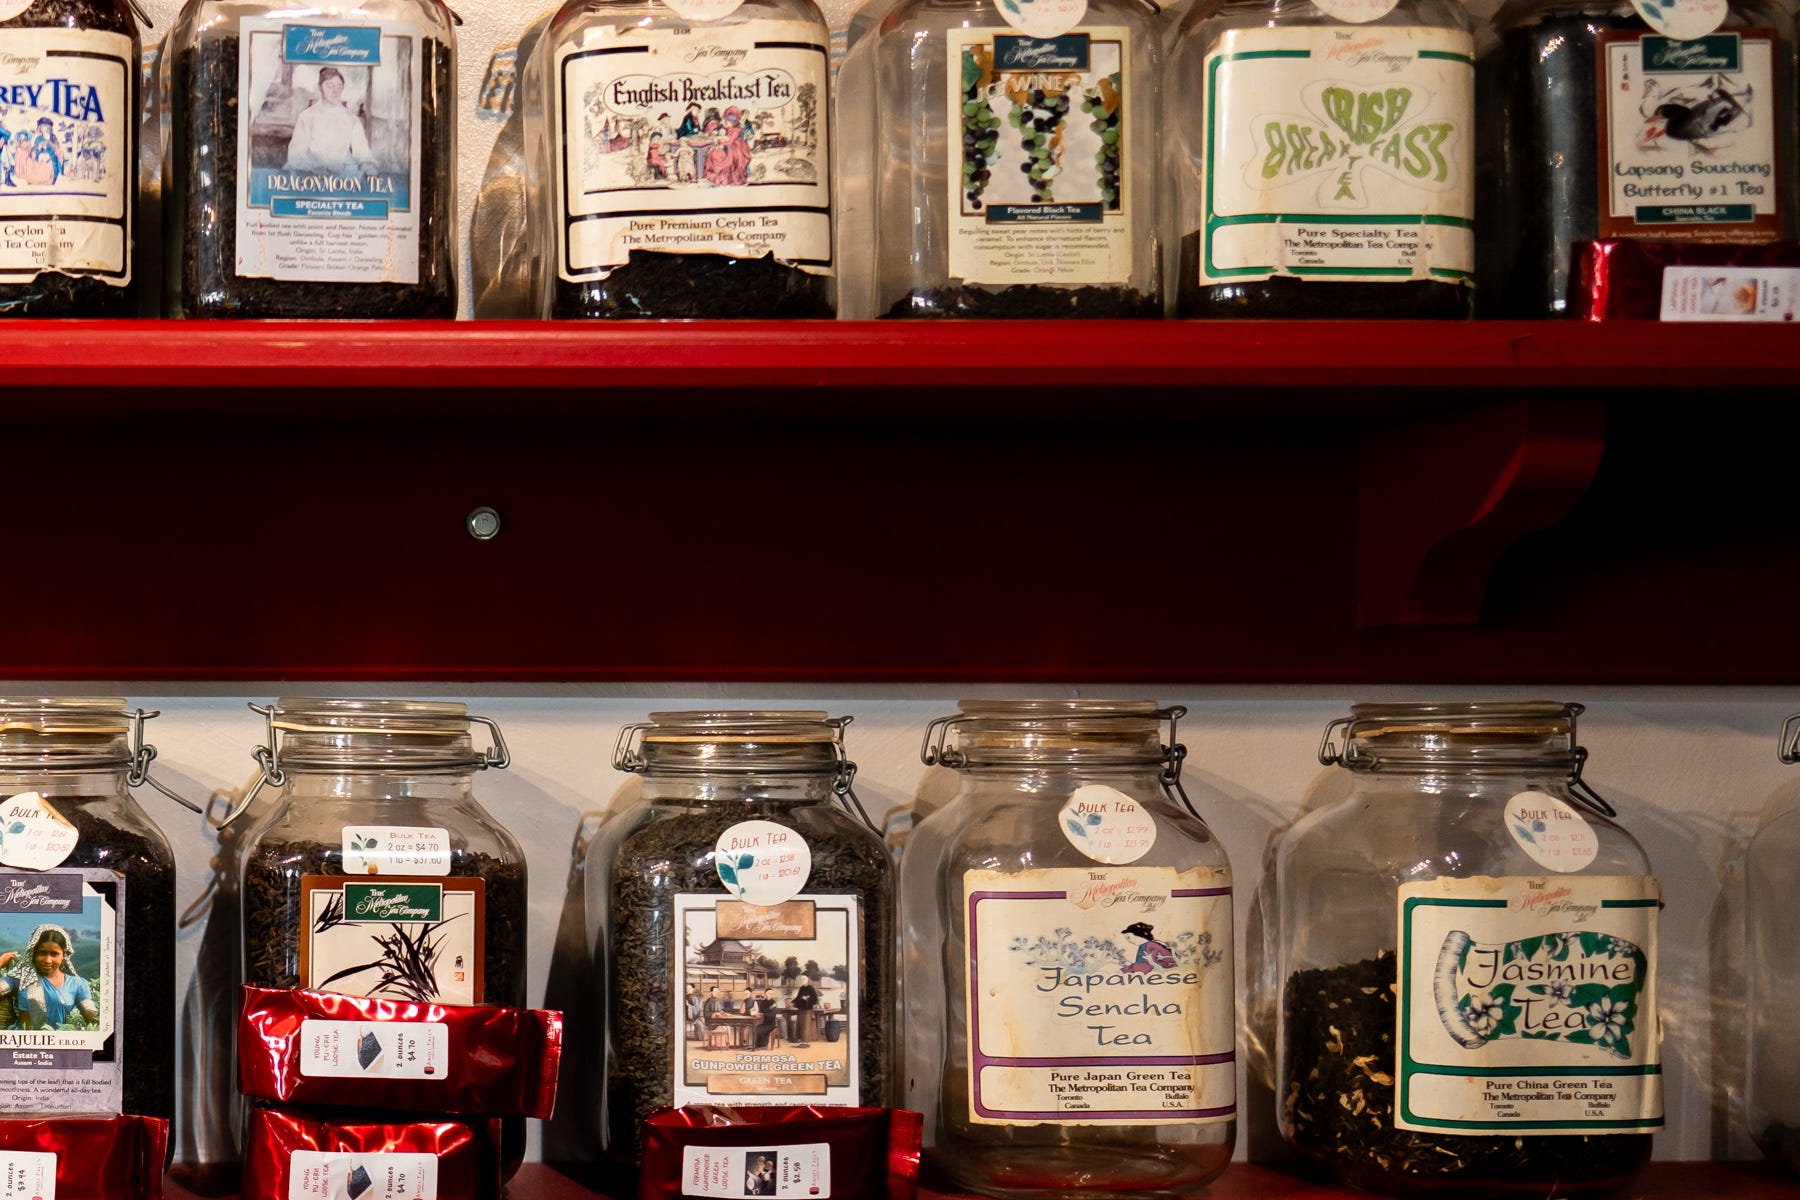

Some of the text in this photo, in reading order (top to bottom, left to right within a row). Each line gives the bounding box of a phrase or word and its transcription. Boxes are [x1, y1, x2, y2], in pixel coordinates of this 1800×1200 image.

[613, 75, 790, 107] English Breakfast Tea
[46, 79, 104, 122] TEA
[1321, 87, 1412, 144] IRISH
[1262, 122, 1454, 182] BREAKFAST
[1614, 162, 1771, 179] Lapsang Souchong
[267, 175, 393, 193] DRAGONMOON TEA
[1624, 181, 1764, 199] Butterfly #1 Tea
[295, 201, 364, 210] SPECIALTY TEA
[630, 217, 778, 230] Pure Premium Ceylon Tea
[4, 225, 43, 238] Ceylon
[717, 233, 733, 241] Tea
[1298, 229, 1418, 239] Pure Specialty Tea
[9, 806, 40, 818] BULK
[1078, 802, 1134, 814] BULK TEA
[1521, 809, 1548, 820] BULK
[416, 843, 438, 851] $4.70
[731, 833, 787, 849] BULK TEA
[1467, 949, 1632, 988] Jasmine
[1037, 967, 1199, 993] Japanese
[1057, 994, 1181, 1017] Sencha
[1513, 998, 1587, 1030] Tea
[1087, 1025, 1152, 1046] Tea
[12, 1051, 54, 1060] Estate Tea
[736, 1054, 796, 1063] FORMOSA
[691, 1058, 841, 1072] GUNPOWDER GREEN TEA
[1051, 1071, 1191, 1083] Pure Japan Green Tea
[1486, 1079, 1613, 1090] Pure China Green Tea
